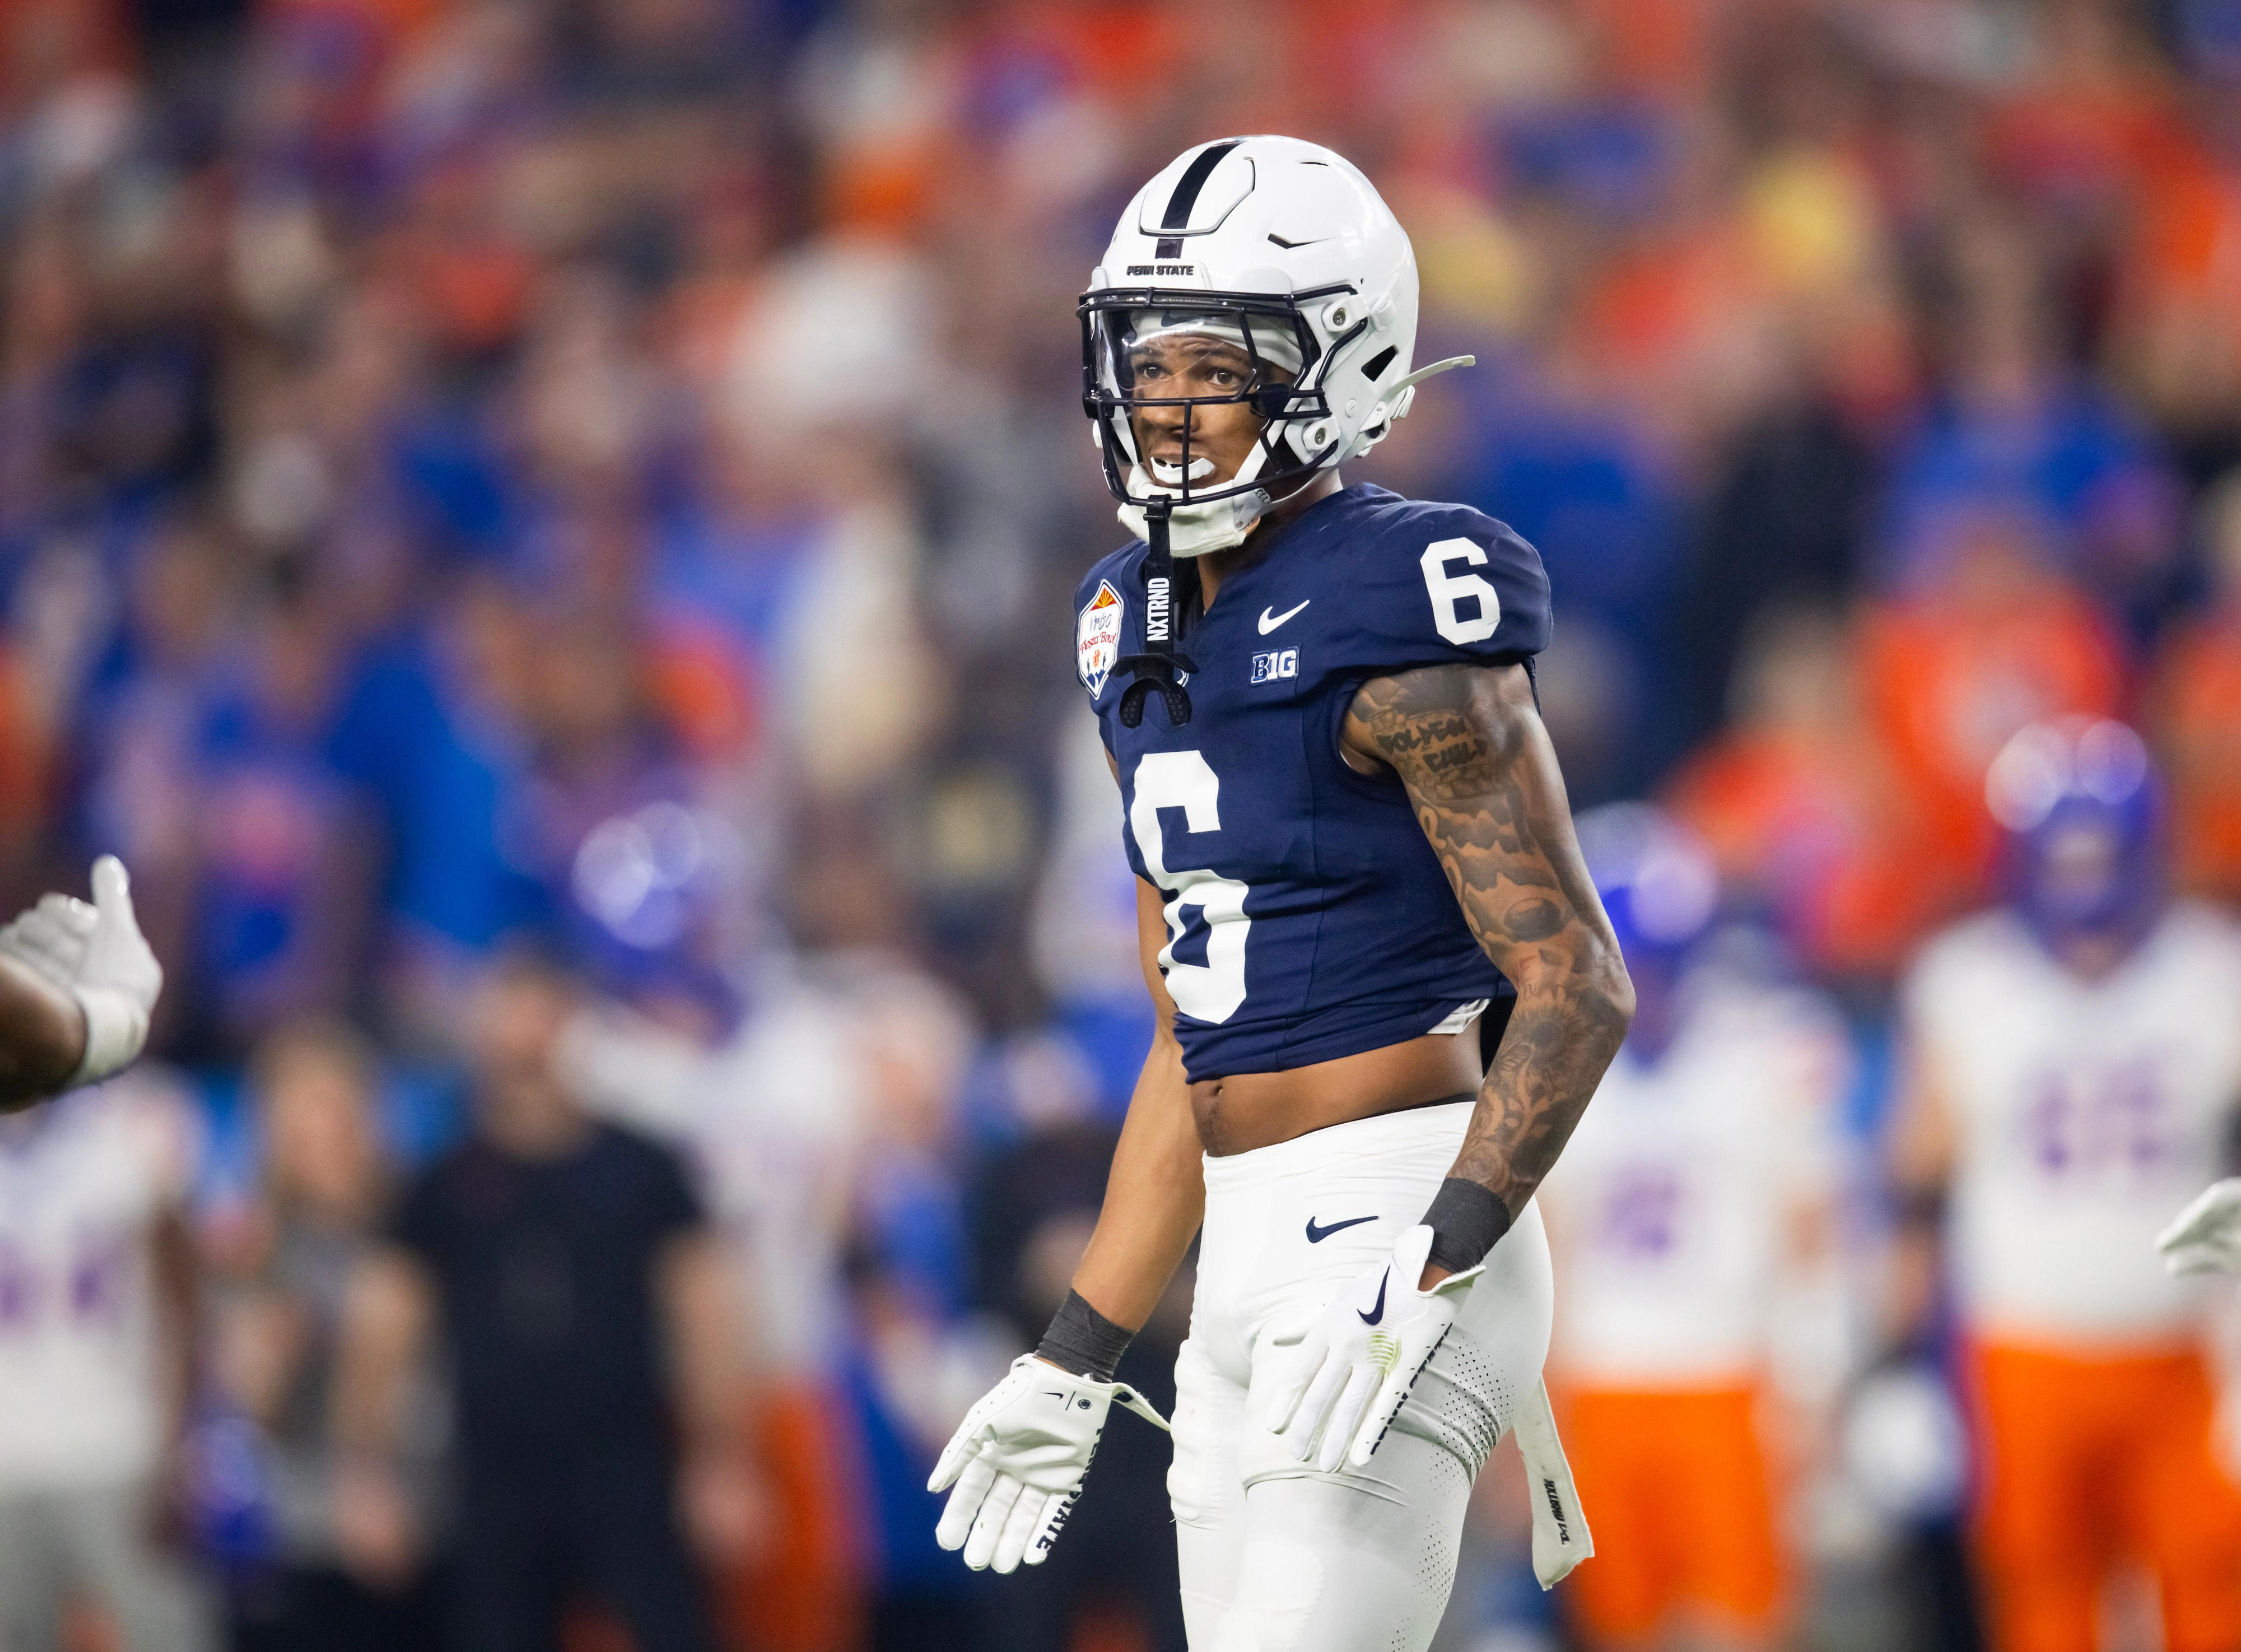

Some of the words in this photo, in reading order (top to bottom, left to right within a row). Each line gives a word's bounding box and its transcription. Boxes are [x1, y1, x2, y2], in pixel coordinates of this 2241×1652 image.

[1126, 266, 1154, 276] PENN
[1156, 265, 1194, 276] STATE
[1147, 578, 1170, 641] NXTRND
[1420, 537, 1501, 645] 6
[1130, 750, 1251, 1025] 6
